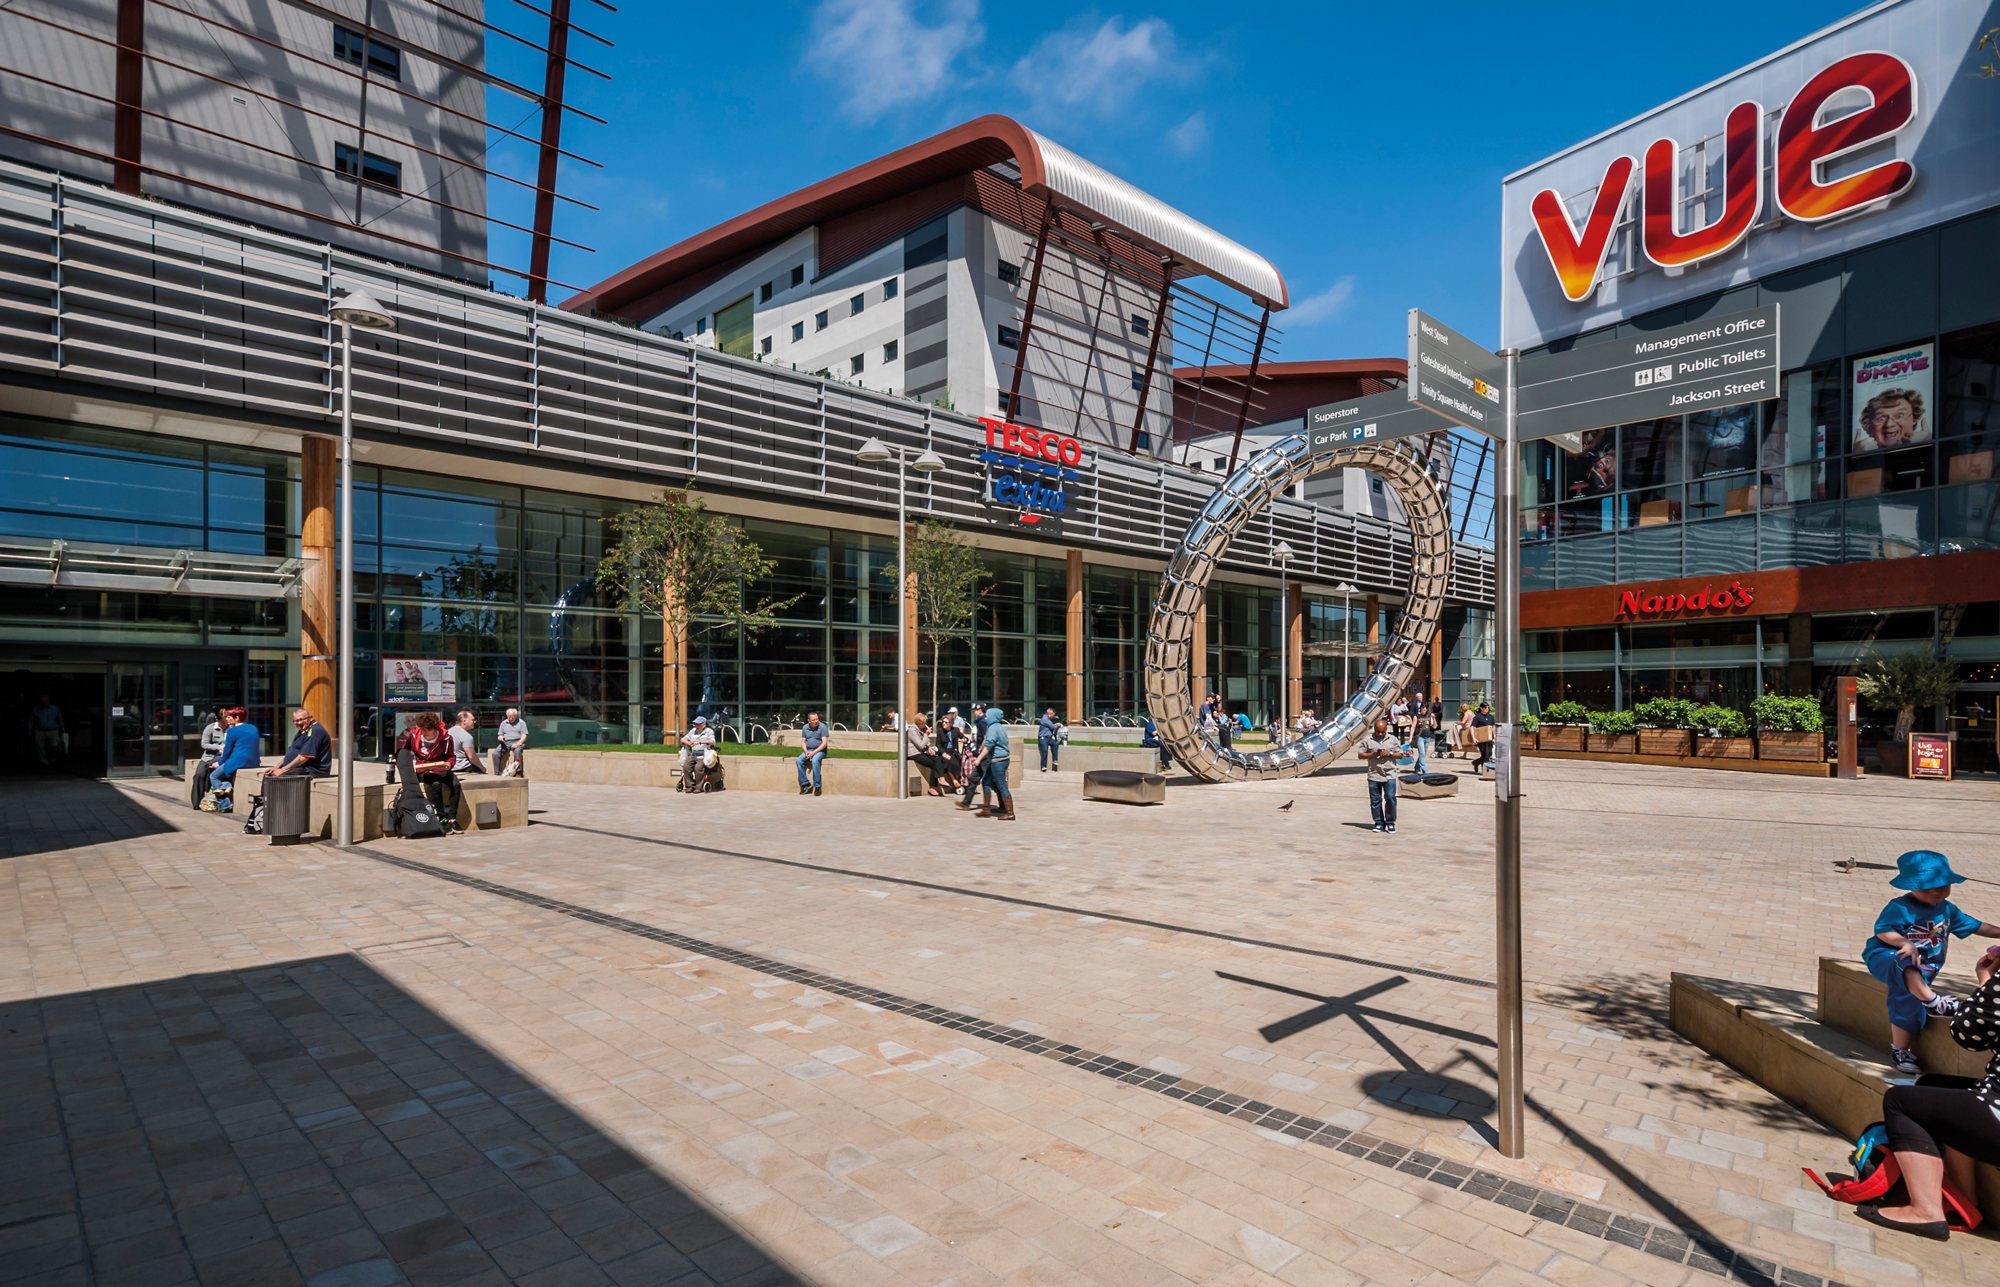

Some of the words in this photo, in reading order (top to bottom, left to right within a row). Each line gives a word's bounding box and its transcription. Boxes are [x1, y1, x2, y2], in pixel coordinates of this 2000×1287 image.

[1420, 320, 1434, 337] West
[1434, 328, 1449, 346] Street
[1635, 327, 1721, 355] Management
[1724, 318, 1766, 335] Office
[1420, 352, 1447, 374] Gateshead
[1447, 365, 1474, 389] Interchange
[1679, 358, 1719, 374] Public
[1721, 349, 1766, 365] Toilets
[1420, 382, 1437, 401] Trinity
[1437, 391, 1454, 407] Square
[1454, 399, 1468, 414] Health
[1469, 406, 1484, 421] Centre
[1669, 388, 1721, 406] Jackson
[1724, 379, 1766, 396] Street
[1314, 407, 1359, 422] Superstore
[978, 416, 1082, 466] TESCO
[1314, 436, 1329, 445] Car
[1330, 431, 1348, 442] Park
[995, 475, 1066, 513] extra
[1618, 581, 1754, 615] Nando's
